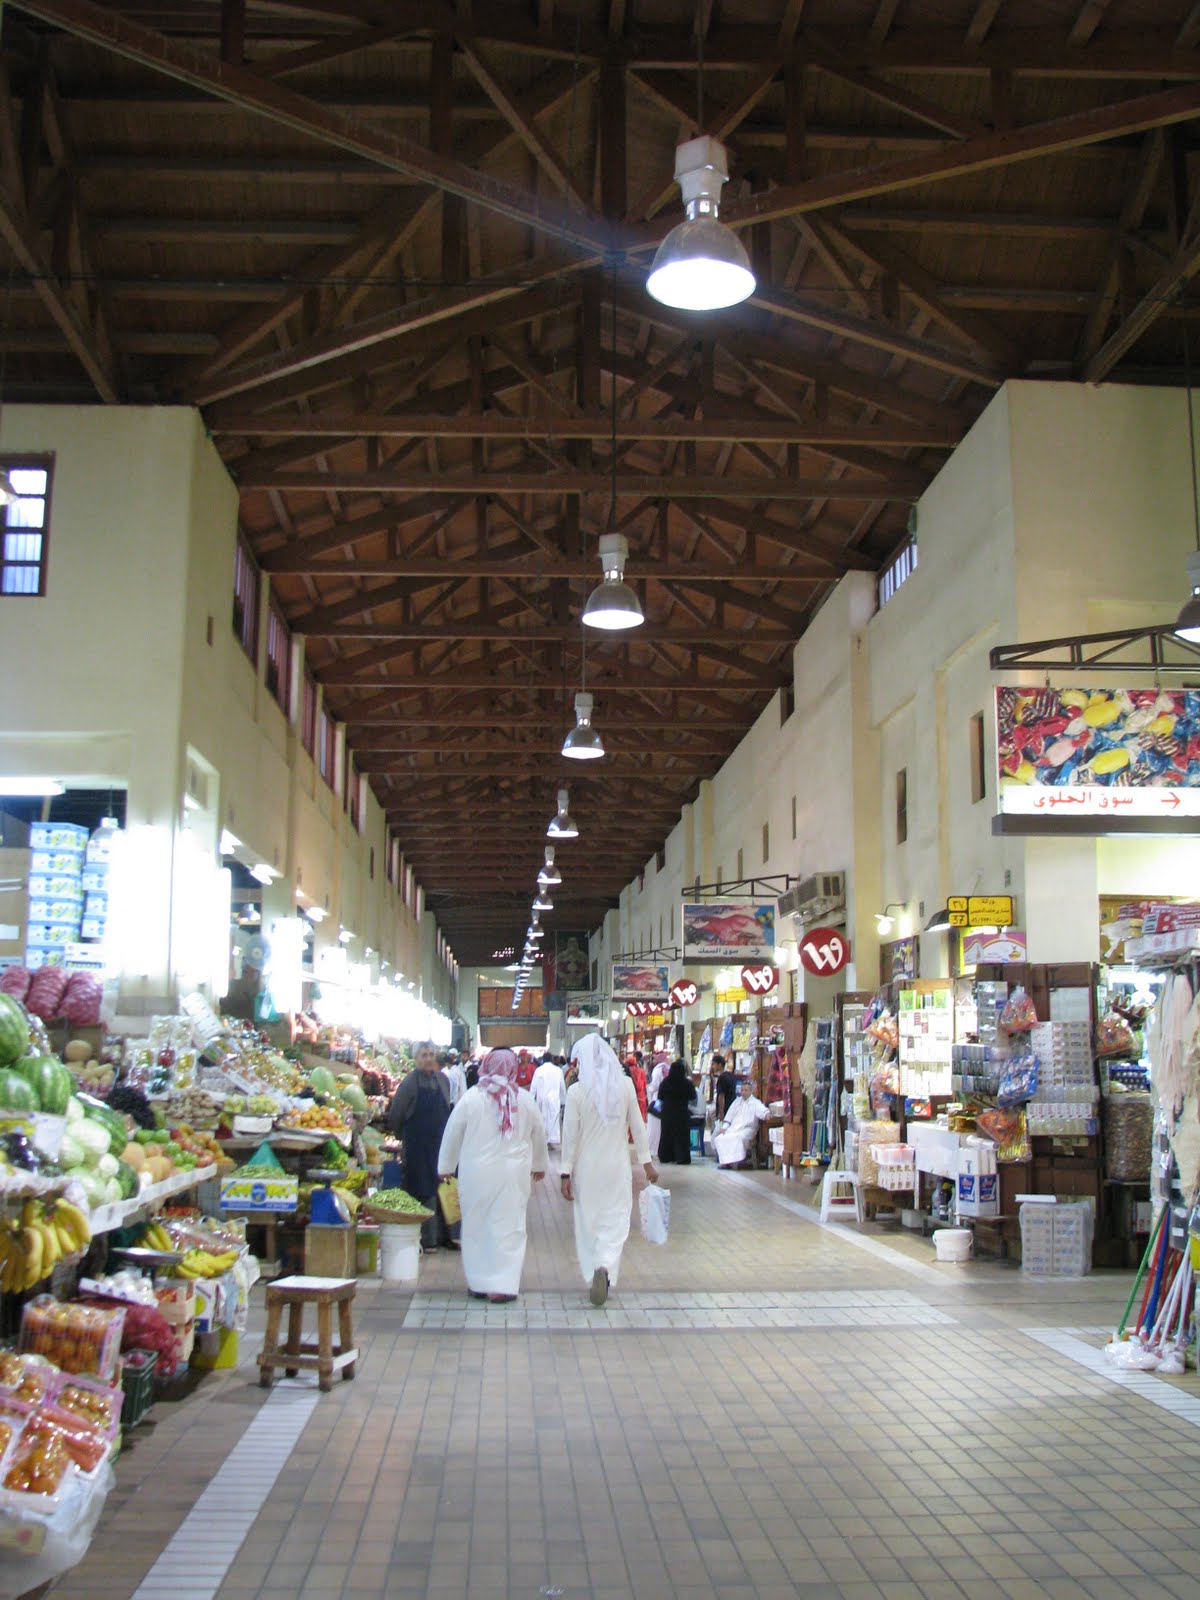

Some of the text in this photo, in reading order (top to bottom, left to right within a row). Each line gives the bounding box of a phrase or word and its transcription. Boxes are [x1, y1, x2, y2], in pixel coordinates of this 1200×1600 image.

[1033, 791, 1133, 808] سوق الحلوى
[952, 914, 965, 925] 37
